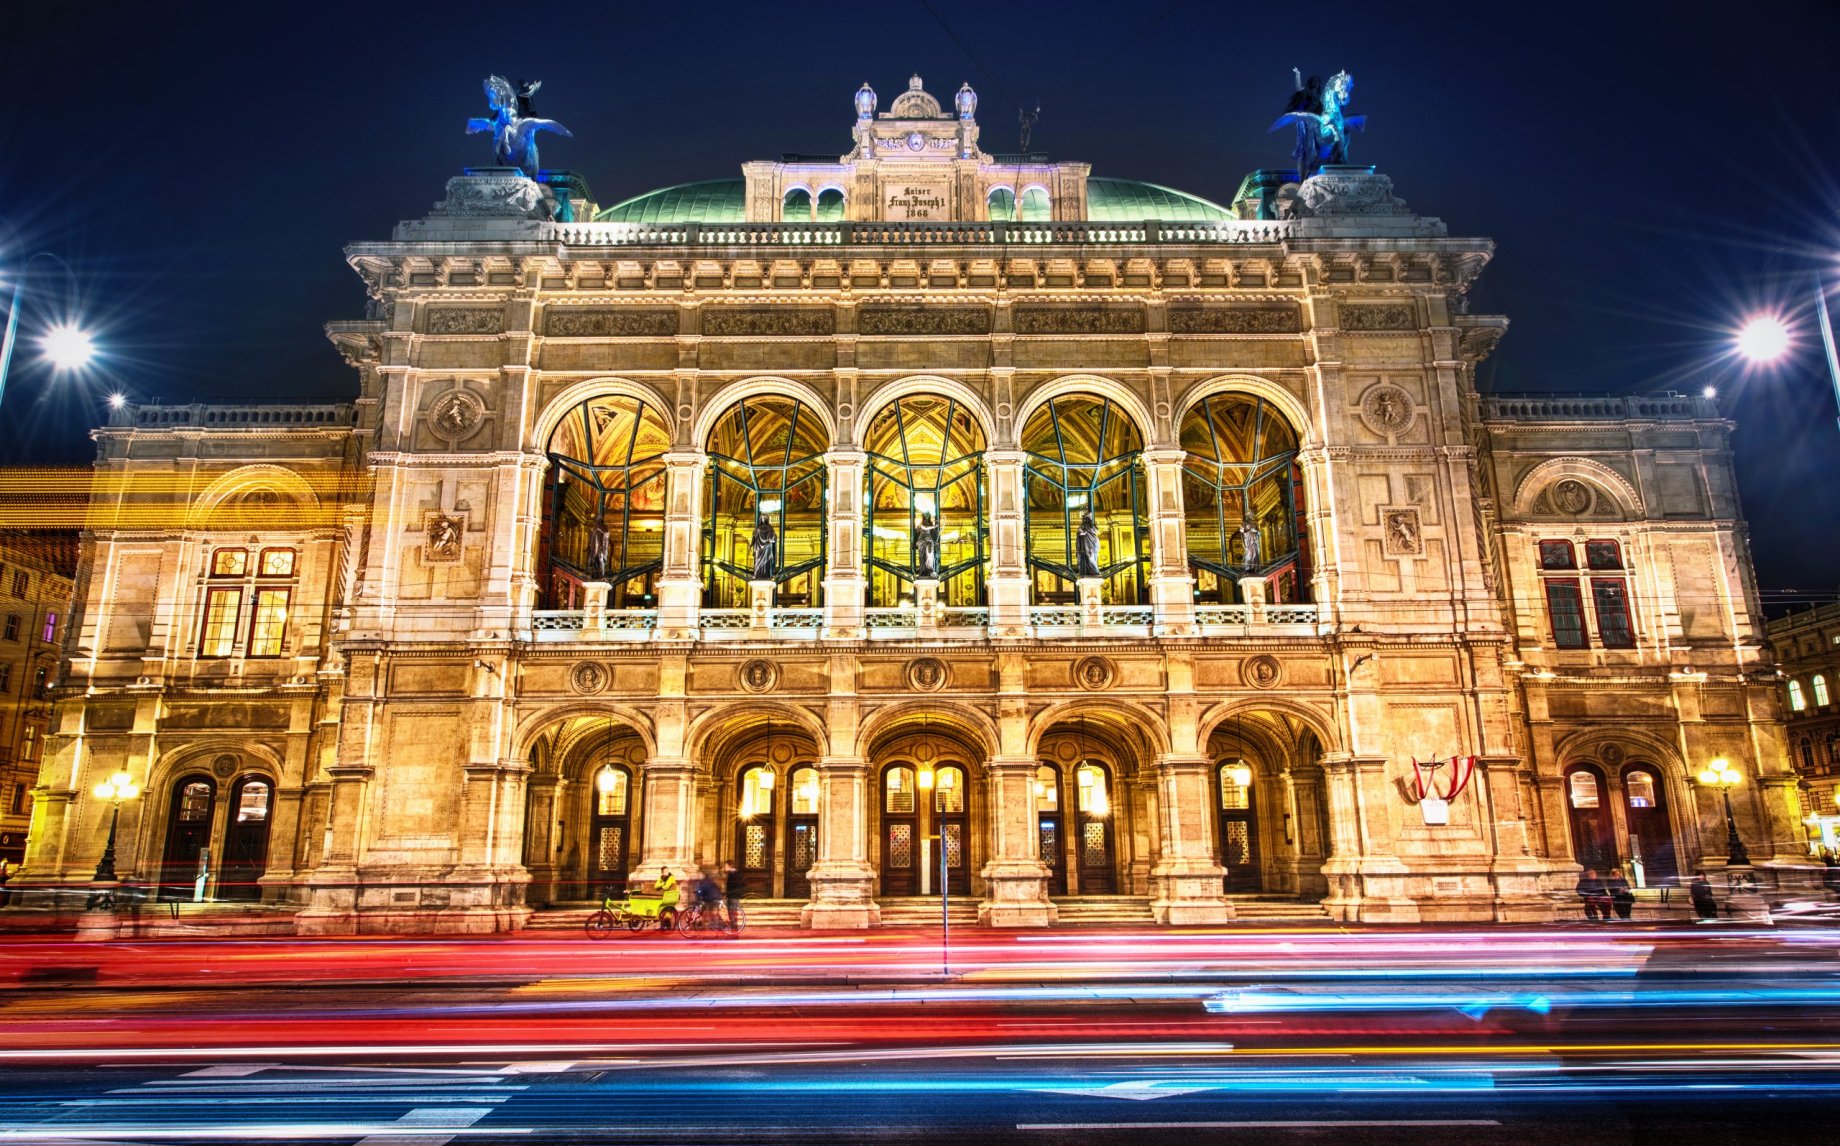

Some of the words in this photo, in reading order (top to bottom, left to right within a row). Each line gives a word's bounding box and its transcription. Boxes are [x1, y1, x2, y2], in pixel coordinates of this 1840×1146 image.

[904, 187, 931, 195] Kaiser
[888, 196, 911, 209] Franz
[912, 196, 940, 209] Joseph
